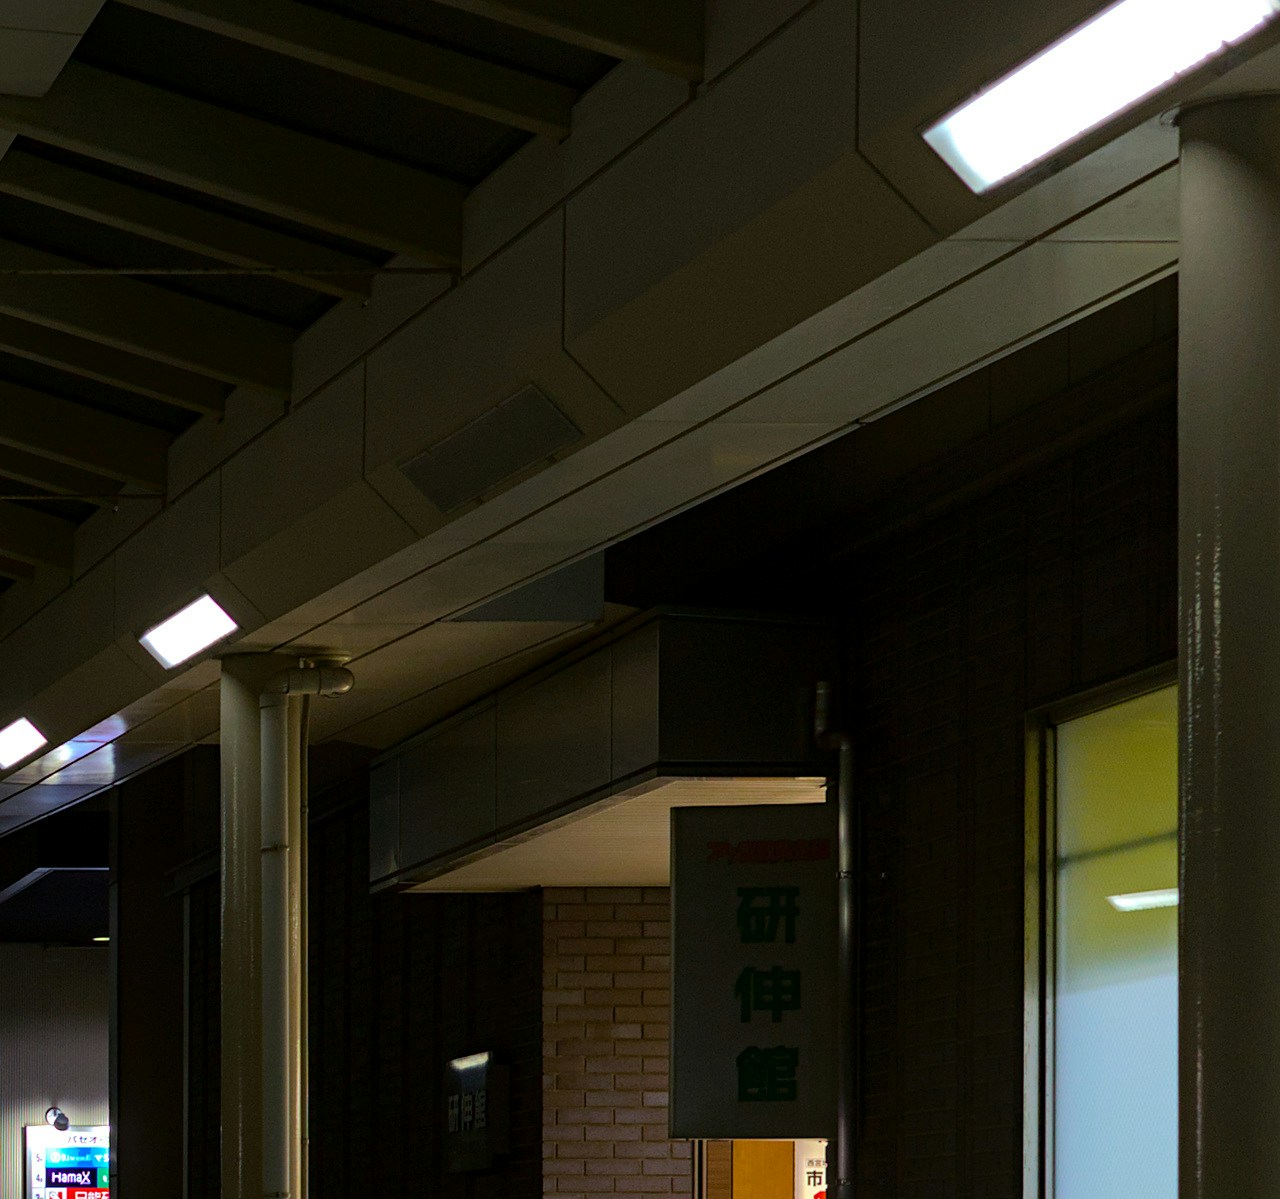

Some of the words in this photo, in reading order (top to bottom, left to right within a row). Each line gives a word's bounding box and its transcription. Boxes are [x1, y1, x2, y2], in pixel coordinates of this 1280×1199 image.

[736, 886, 801, 1102] 研伸館
[51, 1171, 91, 1185] HamaX
[806, 1170, 823, 1187] 市
